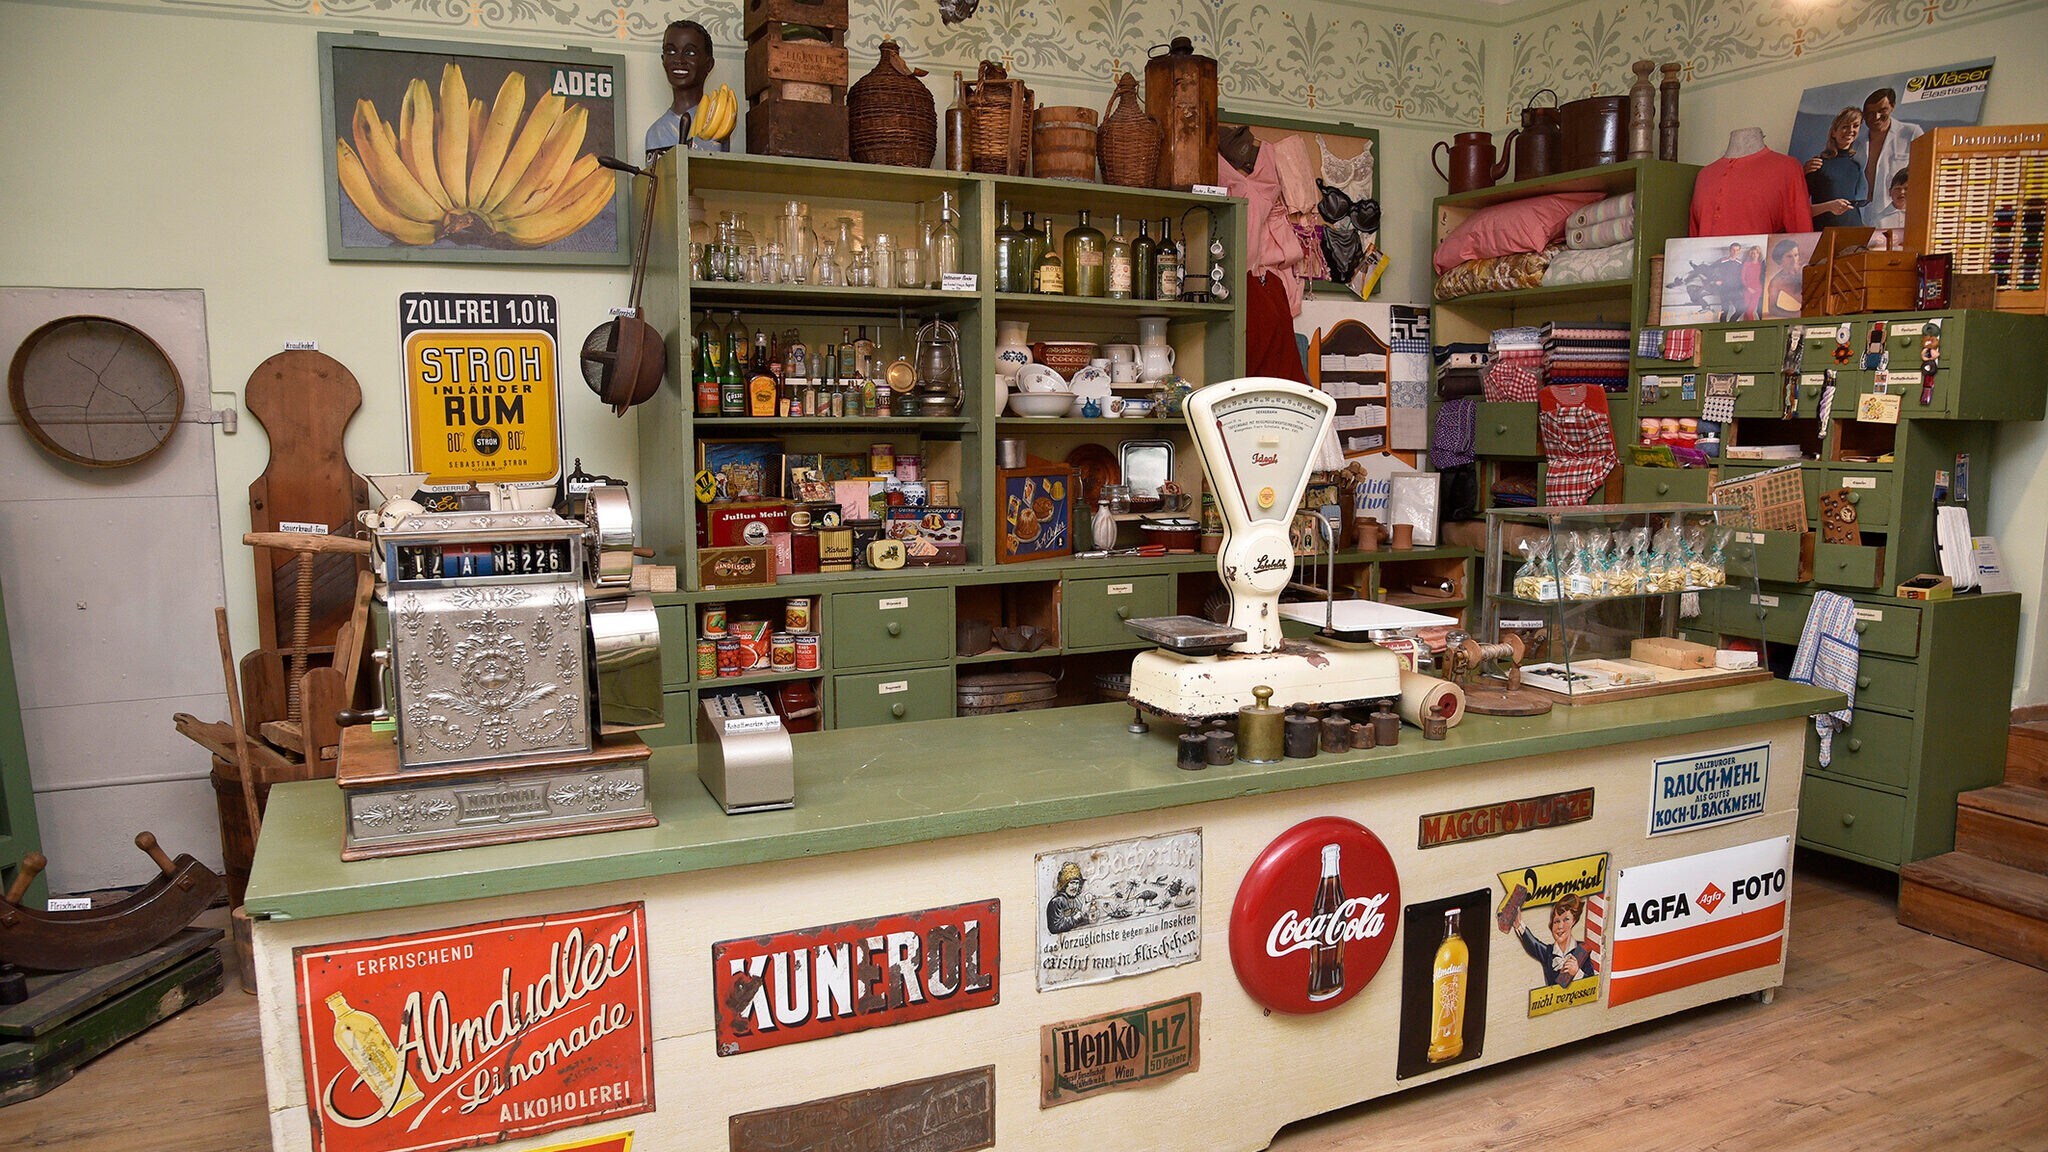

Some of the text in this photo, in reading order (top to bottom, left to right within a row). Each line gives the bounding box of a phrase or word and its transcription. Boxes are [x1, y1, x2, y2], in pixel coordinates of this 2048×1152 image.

[552, 70, 613, 97] ADEG
[1920, 84, 1988, 100] Elastisana
[1952, 132, 2042, 147] Dominator
[405, 299, 499, 324] ZOLLFREI
[421, 347, 541, 383] STROH
[434, 383, 532, 395] INLÄNDER
[444, 395, 525, 426] RUM
[447, 430, 527, 452] 80% STROH 80%
[449, 459, 528, 469] SEBASTIAN STROH
[1252, 452, 1278, 466] Ideal
[722, 513, 757, 521] Julius
[759, 510, 787, 519] Meinl
[1695, 757, 1737, 771] SALZBURGER
[1663, 761, 1761, 800] RAUCH-MEHL
[1695, 789, 1731, 803] ALS GUTES
[1523, 857, 1606, 901] Imperial
[1620, 868, 1786, 928] AGFA Agfa FOTO
[1043, 913, 1197, 954] das Vorzüglichste gegen alle Insekten
[1266, 892, 1390, 958] Coca-Cola
[356, 944, 475, 977] ERFRISCHEND
[1092, 956, 1117, 969] nur
[1117, 952, 1133, 967] in
[725, 919, 992, 1036] KUNEROL
[1531, 985, 1598, 1012] nicht vergessen
[323, 926, 636, 1128] Almdudler
[1061, 1012, 1187, 1074] Henko H7
[458, 1002, 635, 1115] Limonade
[1114, 1064, 1135, 1079] Wien
[1163, 1052, 1187, 1070] Pakete
[499, 1080, 631, 1124] ALKOHOLFREI
